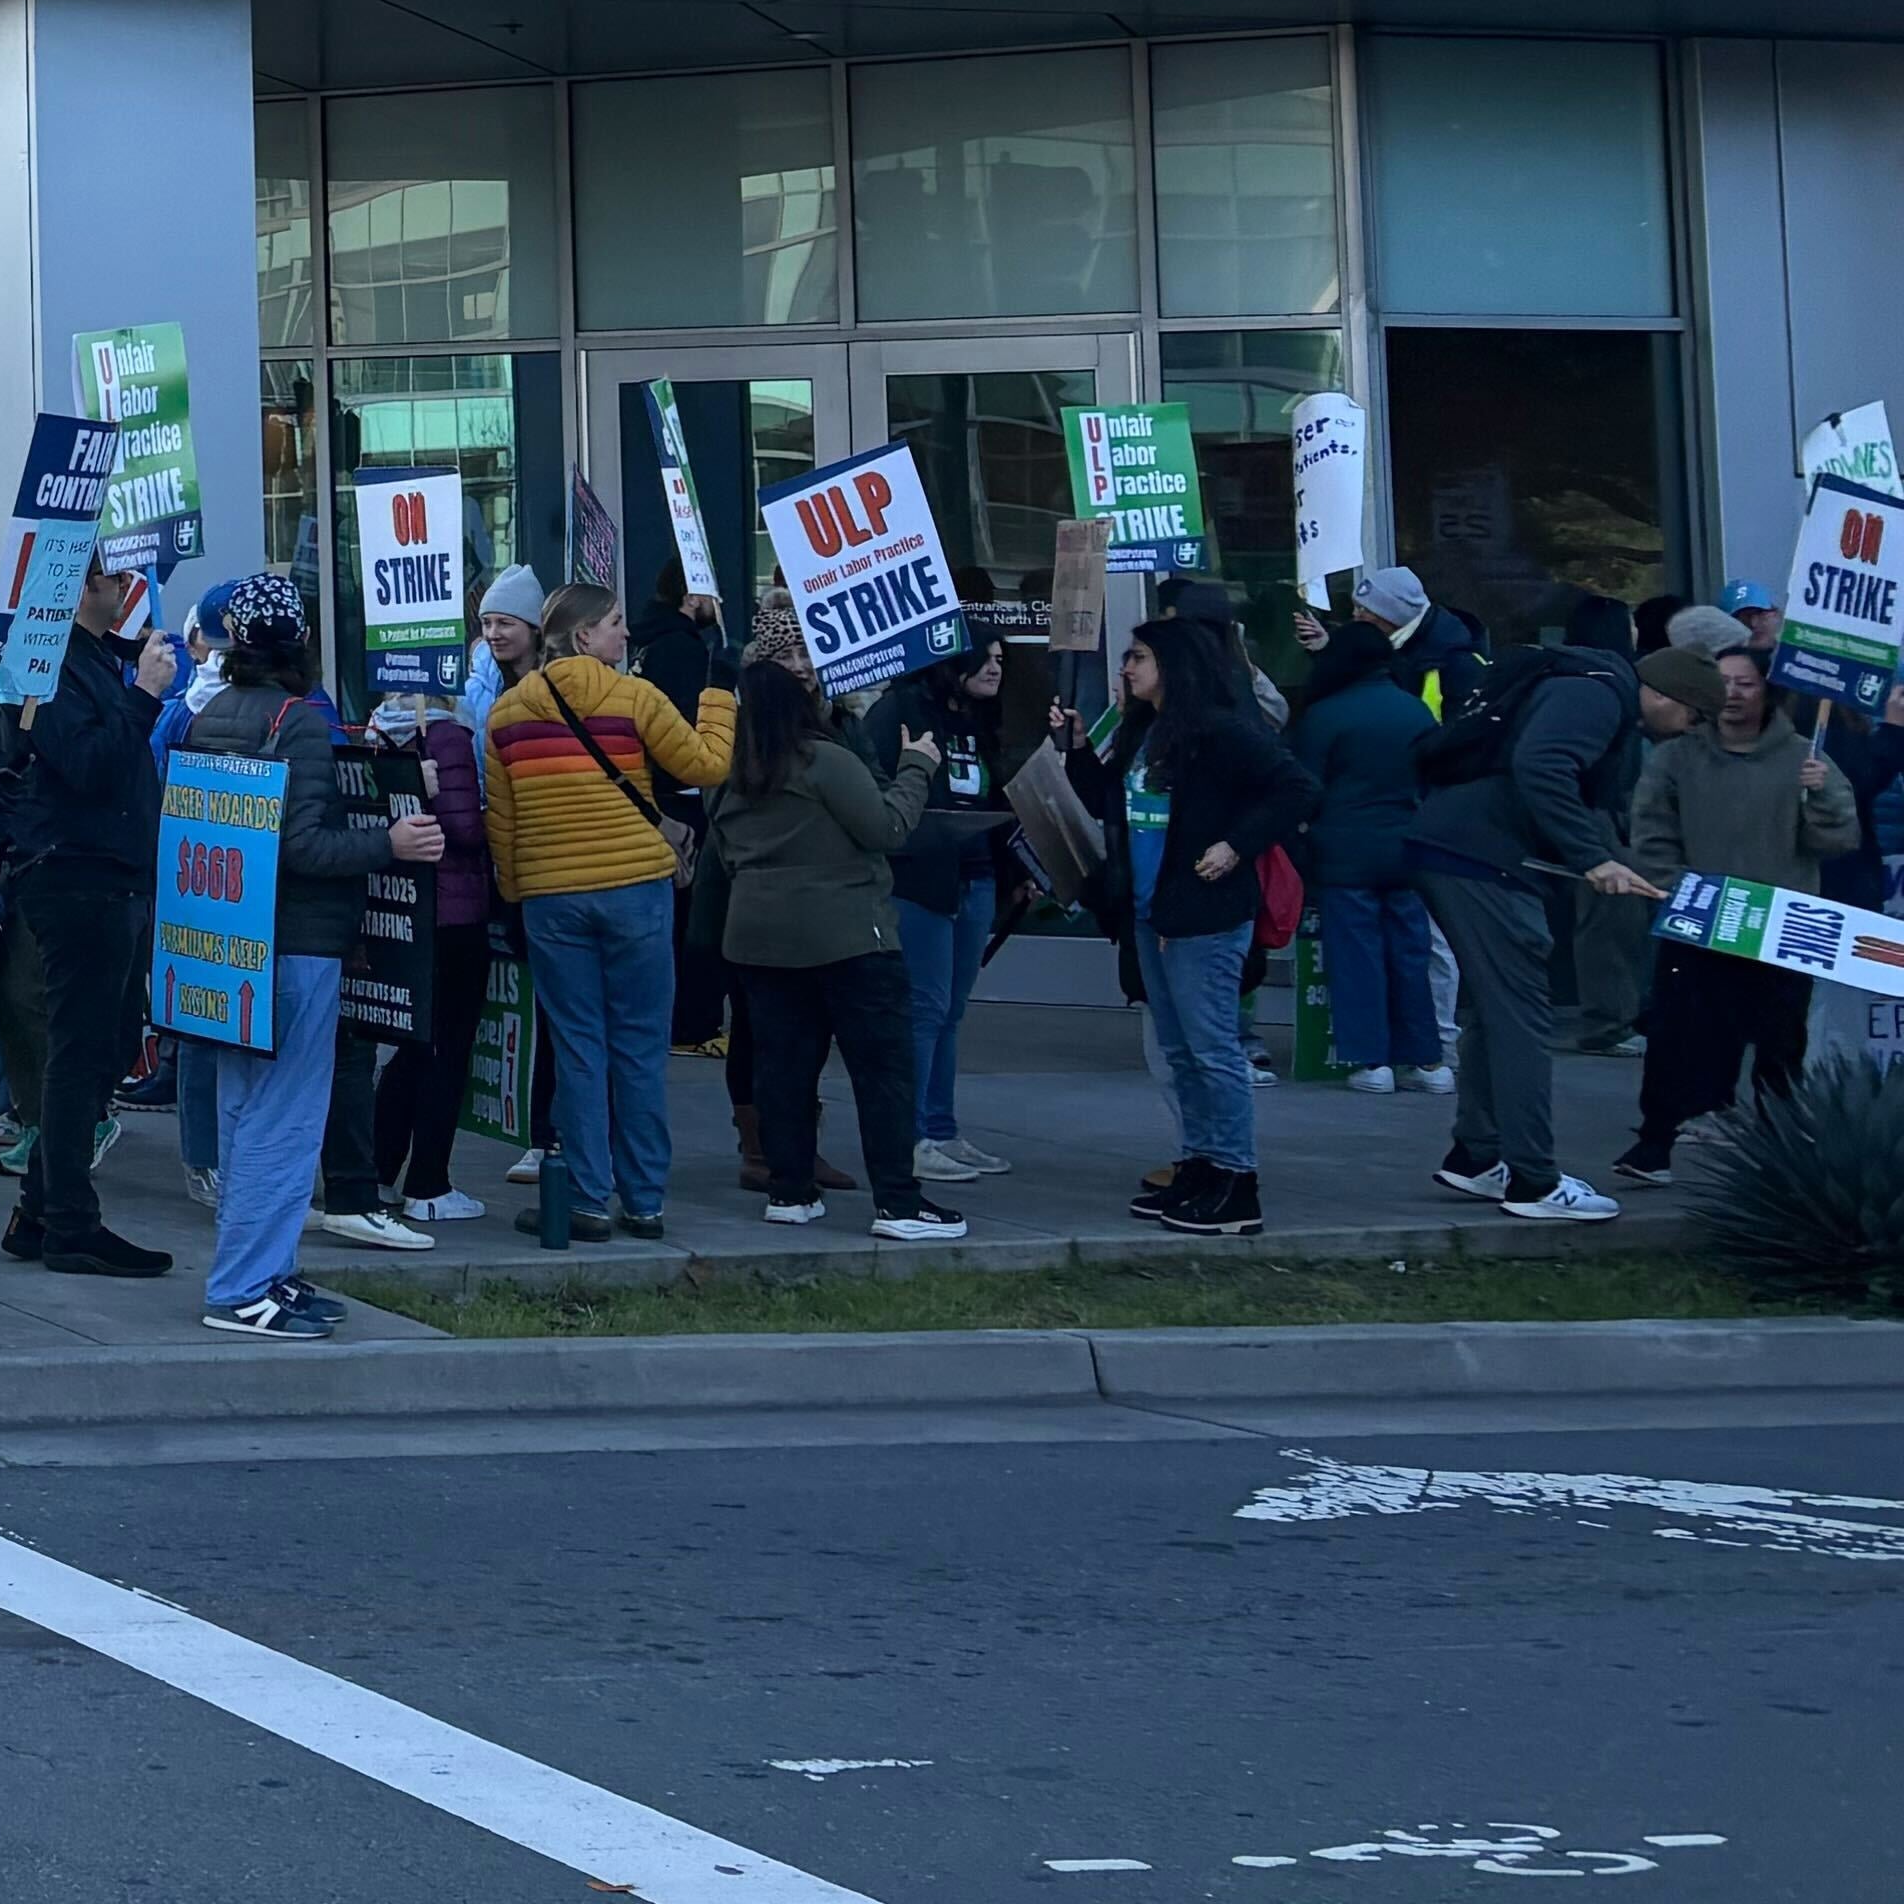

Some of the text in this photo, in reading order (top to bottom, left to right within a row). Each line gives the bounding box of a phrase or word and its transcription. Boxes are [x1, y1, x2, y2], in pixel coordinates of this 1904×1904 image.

[98, 339, 155, 385] Unfair
[122, 422, 182, 460] ractice
[1086, 413, 1153, 443] Unfair
[1296, 417, 1330, 447] ser
[1091, 445, 1157, 472] Labor
[107, 467, 186, 530] STRIKE
[1094, 471, 1187, 501] Practice
[392, 492, 428, 546] ON
[795, 471, 892, 558] ULP
[1840, 508, 1884, 565] ON
[375, 553, 452, 607] STRIKE
[803, 533, 925, 595] Unfair Labor Practice
[806, 555, 948, 655] STRIKE
[1032, 600, 1053, 612] Clo
[1804, 561, 1898, 626] STRIKE
[994, 614, 1031, 625] North
[208, 790, 281, 833] HOARDS
[176, 835, 243, 904] $66B
[383, 875, 417, 904] 2025
[362, 910, 413, 943] TAFFING
[1776, 900, 1846, 971] STRIKE
[228, 935, 268, 972] KEEP
[180, 983, 229, 1024] RISING
[486, 960, 520, 1005] STR
